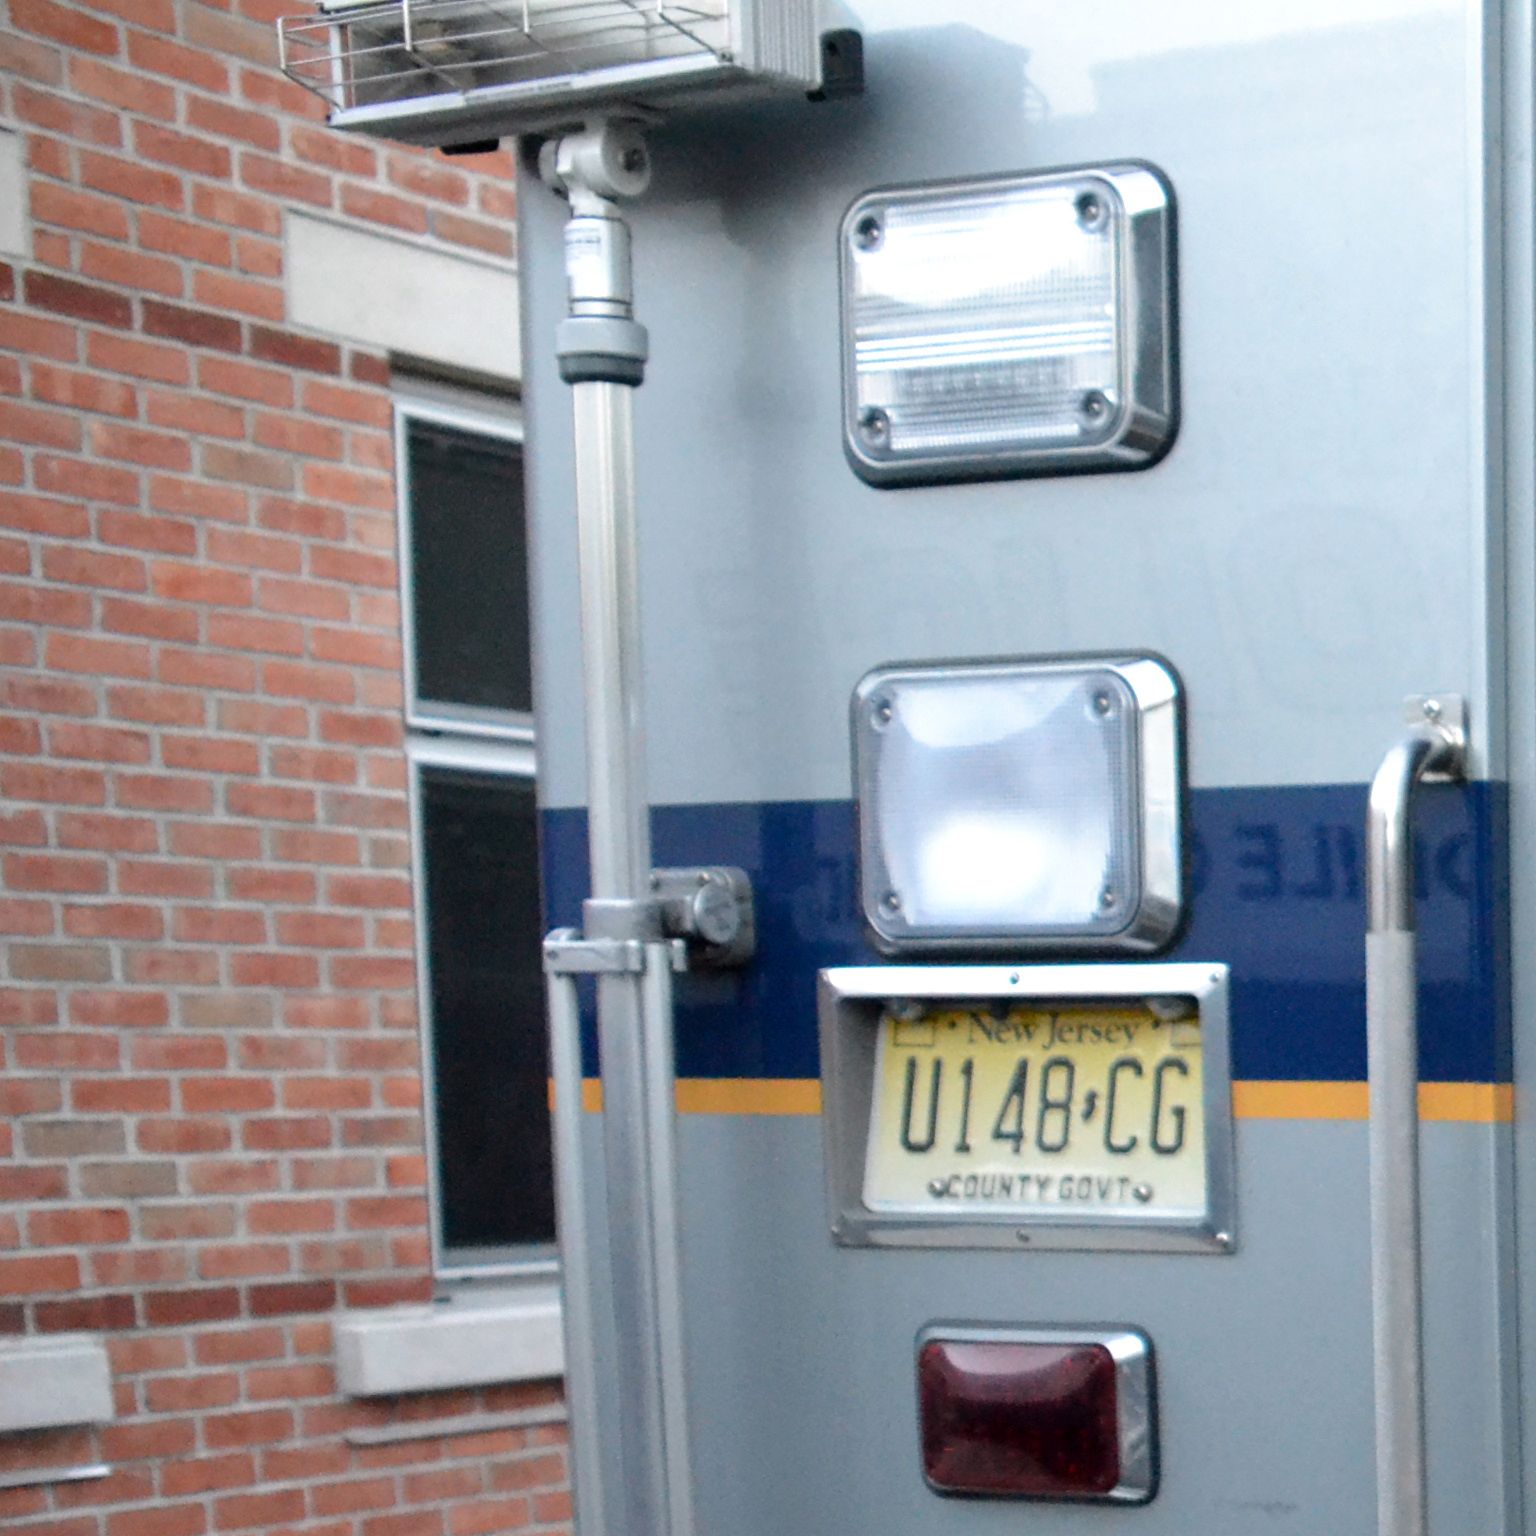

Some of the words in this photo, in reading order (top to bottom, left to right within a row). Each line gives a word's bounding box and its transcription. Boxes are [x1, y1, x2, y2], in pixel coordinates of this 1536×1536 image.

[967, 1012, 1038, 1043] New
[1042, 1012, 1140, 1050] Jersey
[943, 1173, 1050, 1200] COUNTY
[1059, 1175, 1131, 1201] GOVT
